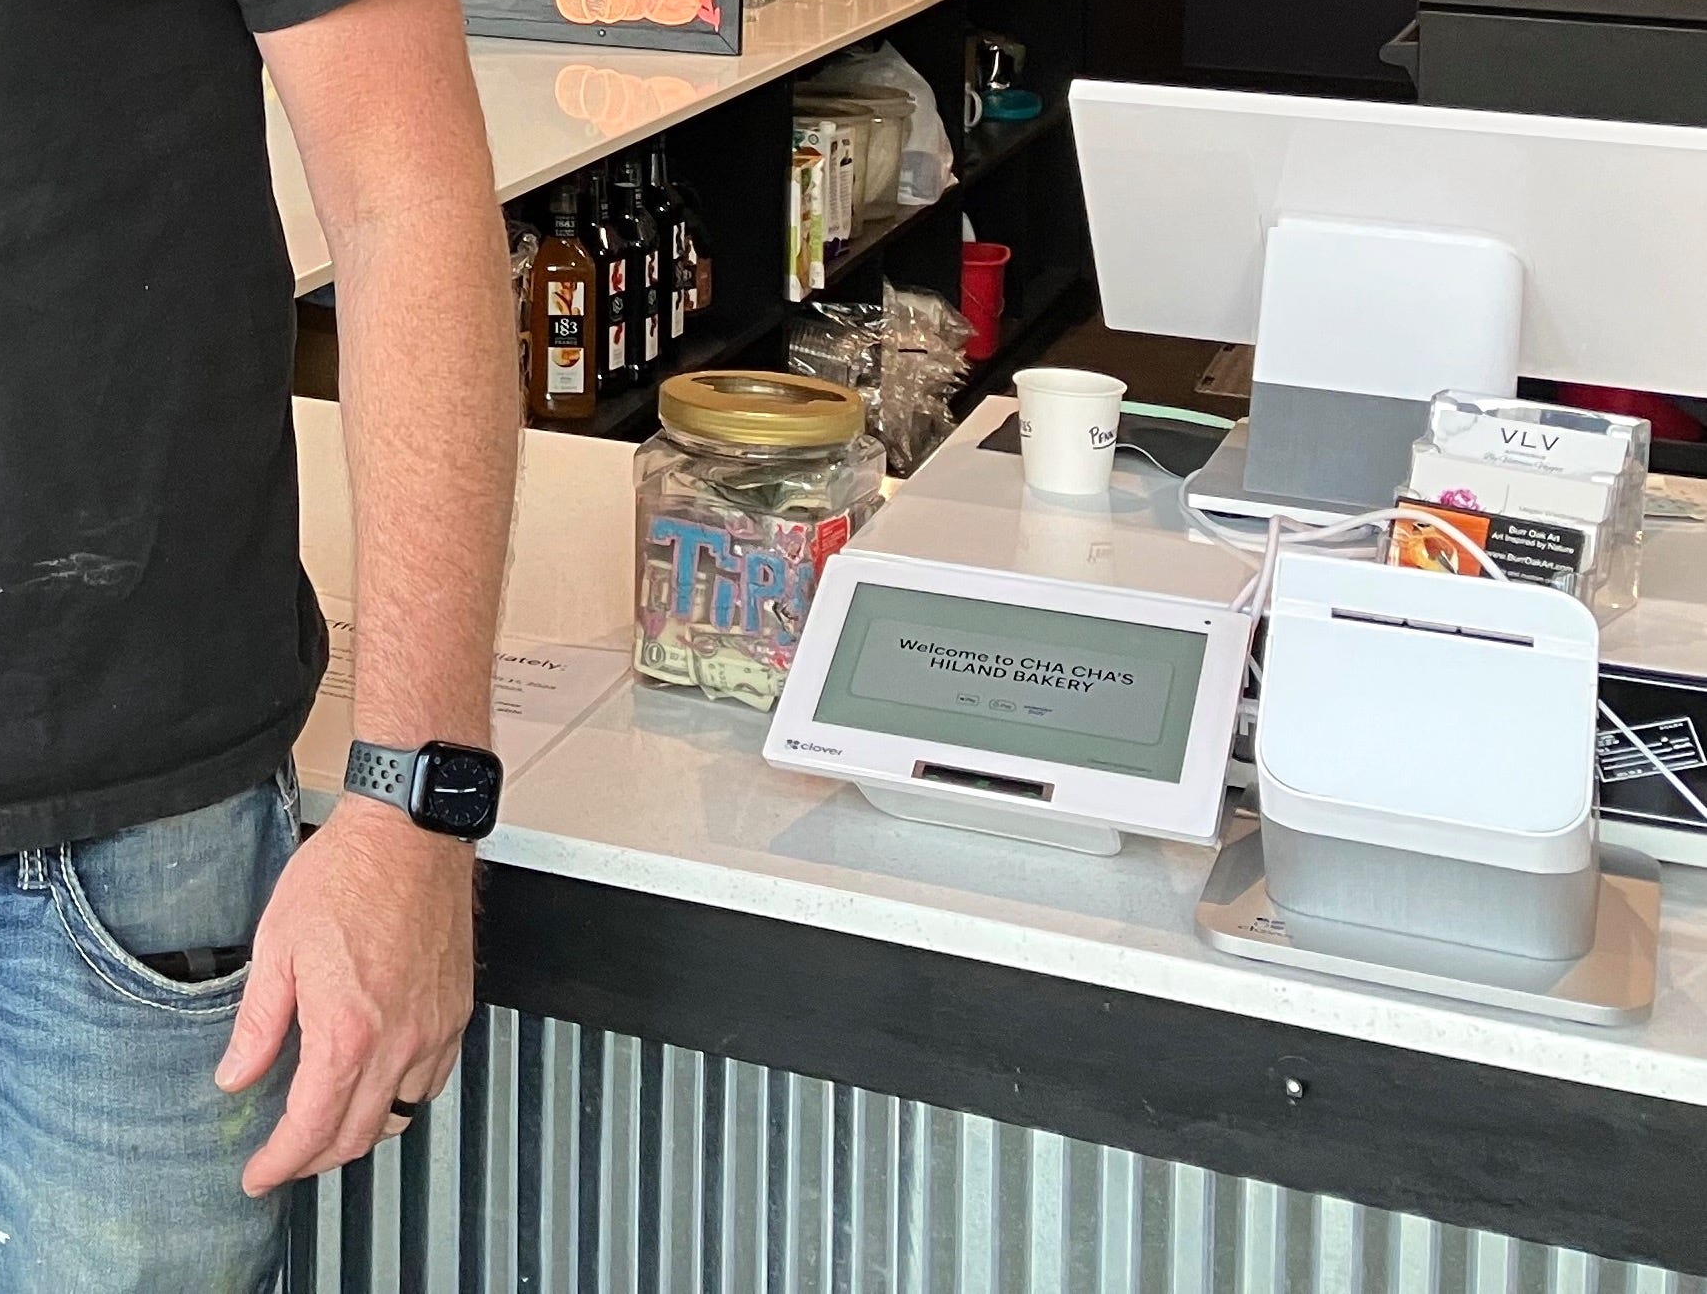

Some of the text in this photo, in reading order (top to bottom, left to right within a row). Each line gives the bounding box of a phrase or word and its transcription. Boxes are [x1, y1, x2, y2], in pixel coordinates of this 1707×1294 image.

[1500, 427, 1560, 451] VLV
[1547, 534, 1561, 543] Art
[899, 638, 1135, 686] Welcome to CHA CHA'S
[929, 657, 1095, 693] HILAND BAKERY
[801, 742, 843, 756] clover
